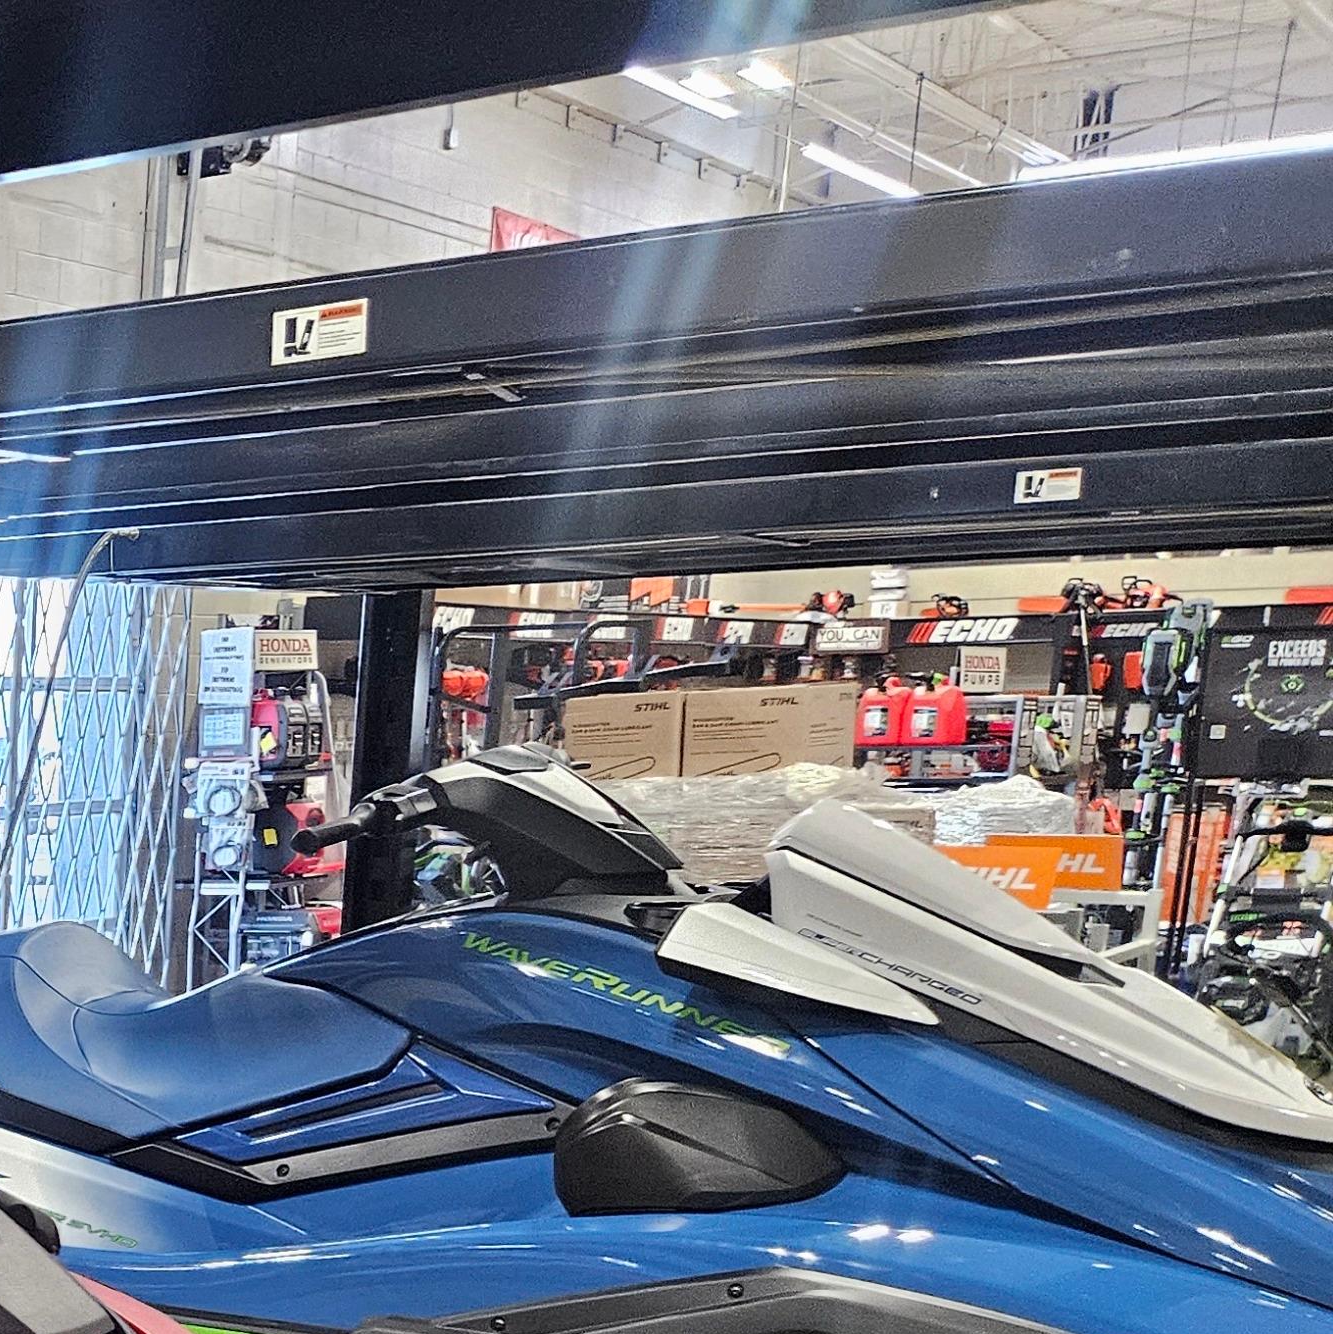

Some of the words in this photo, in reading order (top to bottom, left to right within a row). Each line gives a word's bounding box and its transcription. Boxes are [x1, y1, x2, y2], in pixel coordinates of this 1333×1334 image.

[820, 628, 843, 641] YOU
[853, 627, 881, 640] CAN
[933, 618, 1019, 642] ECHO
[1101, 623, 1159, 638] ECHO
[260, 639, 311, 652] HONDA
[1268, 639, 1327, 657] EXCEEDS
[965, 655, 1000, 670] HONDA
[964, 674, 1001, 686] PUMPS
[634, 702, 670, 712] STIHL
[760, 698, 799, 707] STIHL
[964, 866, 1036, 890] IHL
